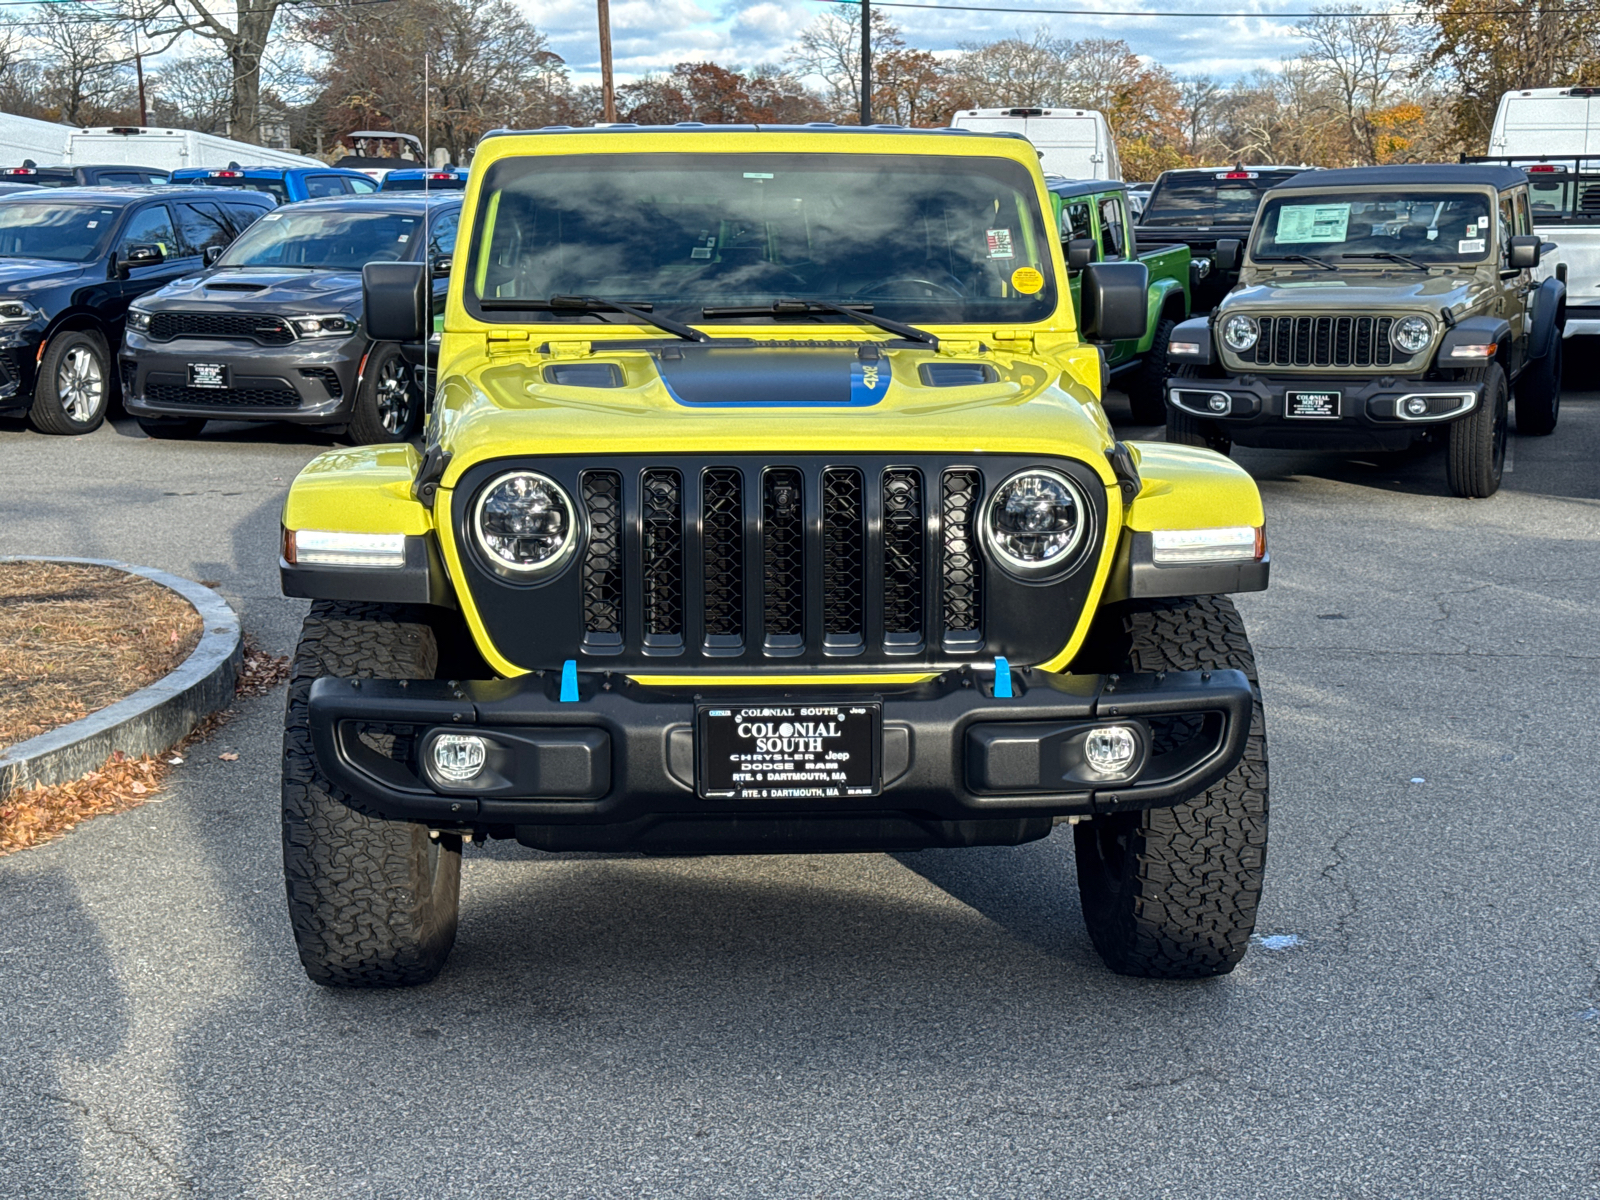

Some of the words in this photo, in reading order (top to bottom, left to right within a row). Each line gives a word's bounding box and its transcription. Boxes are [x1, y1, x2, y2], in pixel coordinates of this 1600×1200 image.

[741, 708, 795, 717] COLONIAL
[800, 707, 838, 716] SOUTH
[849, 707, 866, 715] Jeep
[737, 722, 842, 738] COLONIAL
[756, 737, 823, 752] SOUTH
[729, 753, 815, 761] CHRYSLER
[825, 750, 850, 761] Jeep
[741, 762, 794, 770] DODGE
[732, 773, 754, 781] RTE.
[756, 773, 763, 781] 6
[767, 772, 830, 781] DARTMOUTH,
[831, 772, 847, 780] MA
[742, 790, 761, 798] RTE.
[762, 790, 768, 798] 6
[771, 789, 825, 797] DARTMOUTH,
[826, 788, 839, 796] MA
